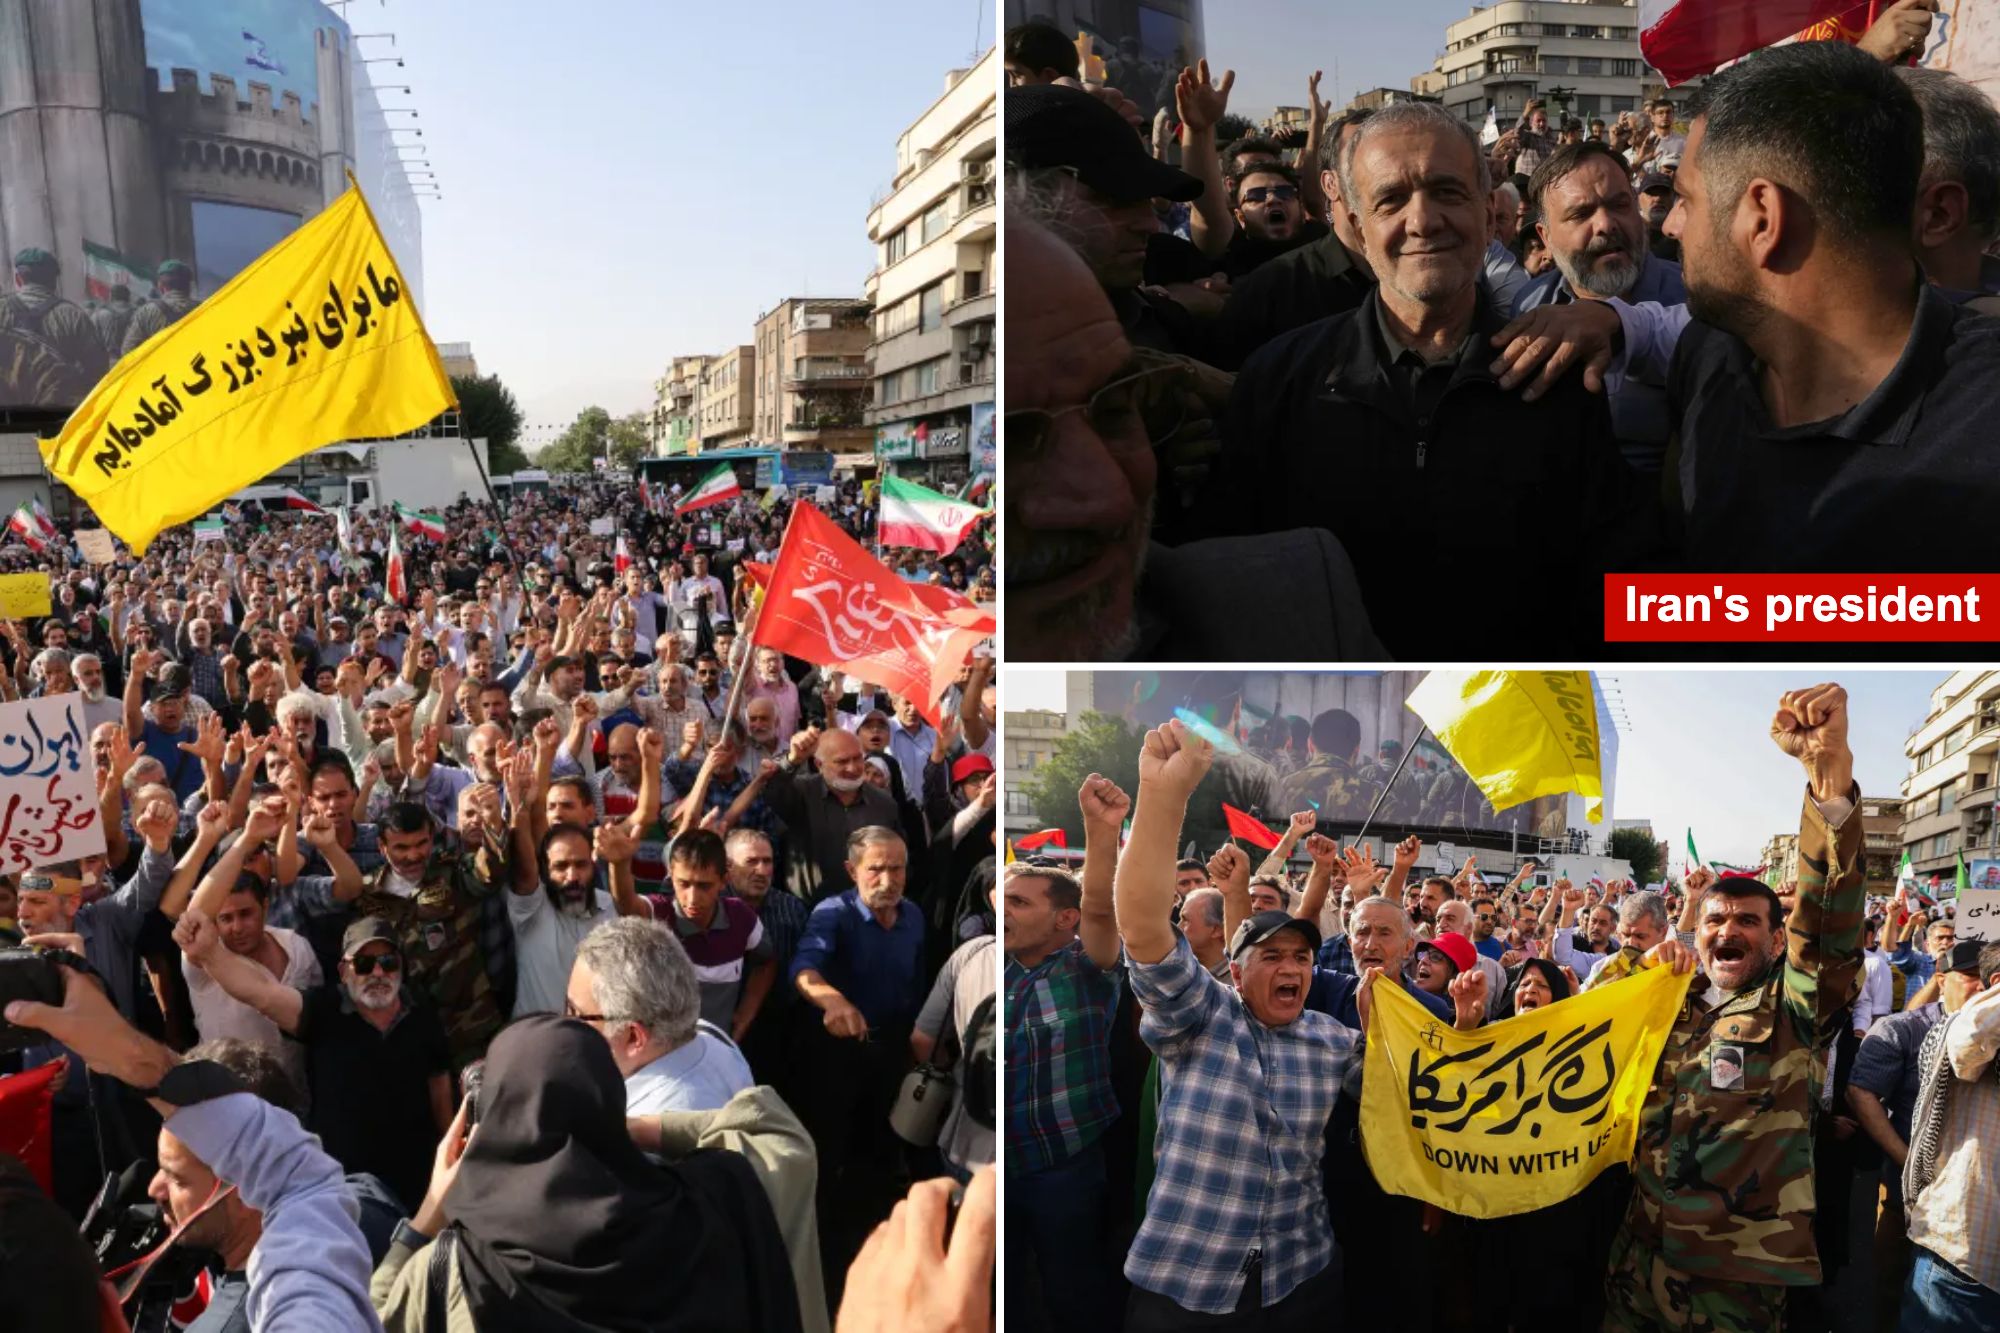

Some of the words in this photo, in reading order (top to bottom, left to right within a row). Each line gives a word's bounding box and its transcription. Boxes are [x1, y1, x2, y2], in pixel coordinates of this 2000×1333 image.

[314, 279, 377, 350] برای
[366, 261, 401, 307] ما
[256, 300, 310, 366] نبرد
[182, 339, 262, 396] بزرگ
[0, 704, 82, 777] ایران
[1422, 1141, 1499, 1175] DOWN
[1508, 1146, 1579, 1175] WITH
[1588, 1120, 1618, 1157] US
